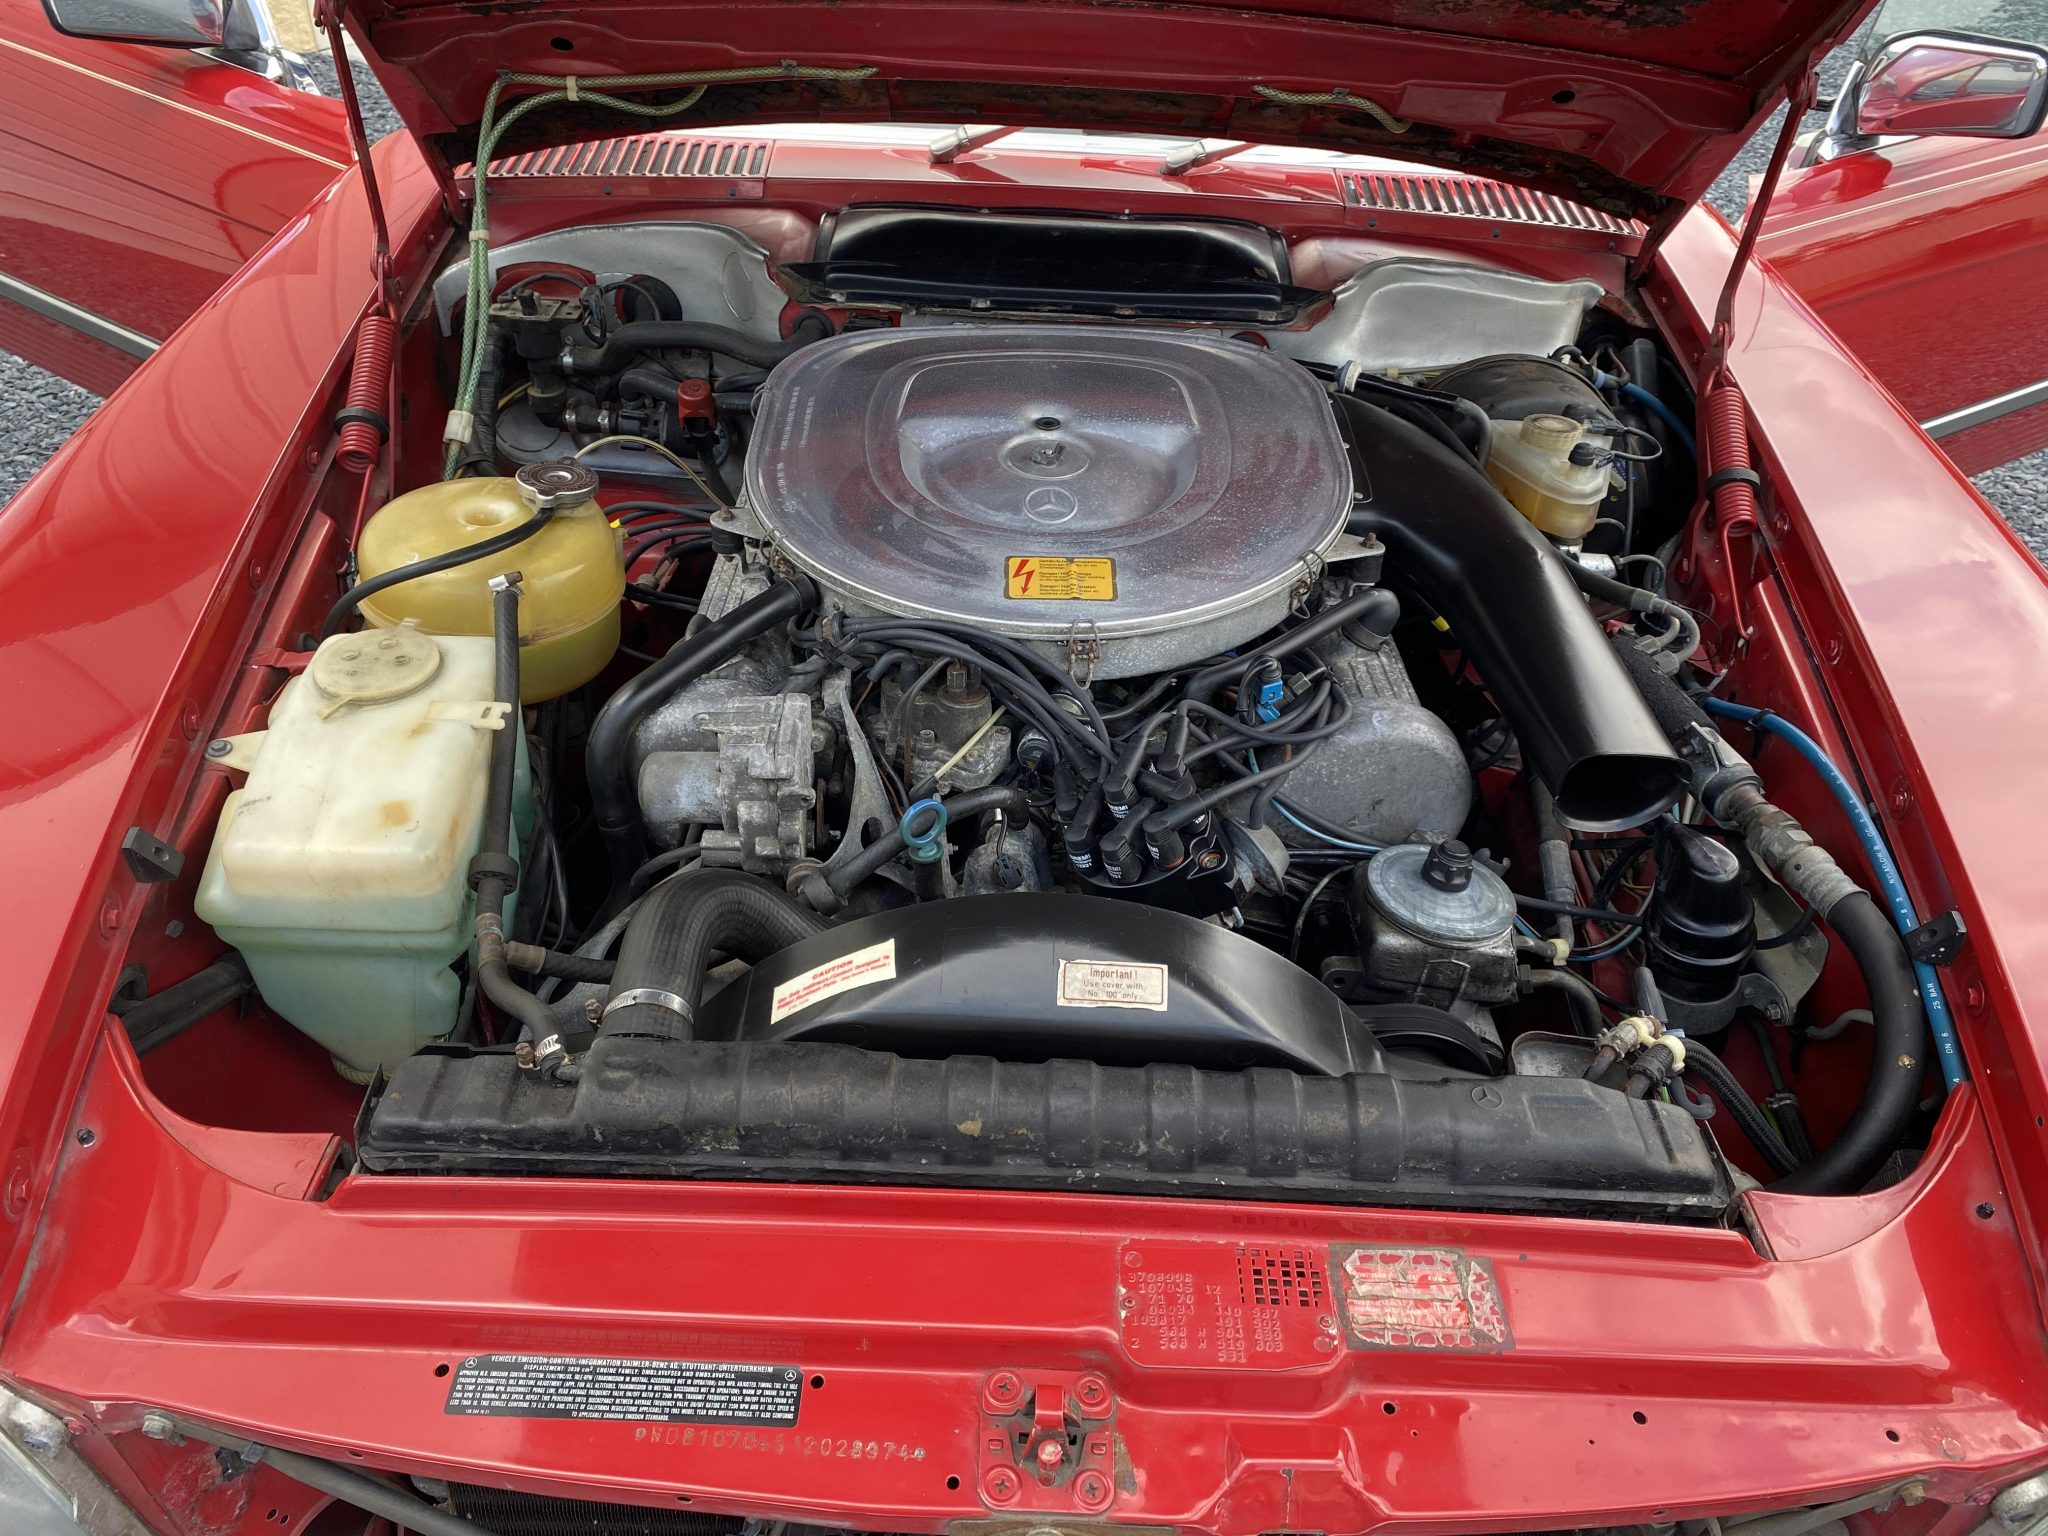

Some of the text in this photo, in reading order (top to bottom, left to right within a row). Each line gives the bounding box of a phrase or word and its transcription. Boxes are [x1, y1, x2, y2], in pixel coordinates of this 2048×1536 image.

[812, 960, 853, 980] CAUTION
[1927, 982, 1937, 998] BAR
[1934, 1000, 1941, 1010] 25
[1177, 1294, 1194, 1305] 70
[1214, 1295, 1222, 1305] 1
[1131, 1338, 1140, 1349] 2
[491, 1354, 515, 1362] VEHICLE
